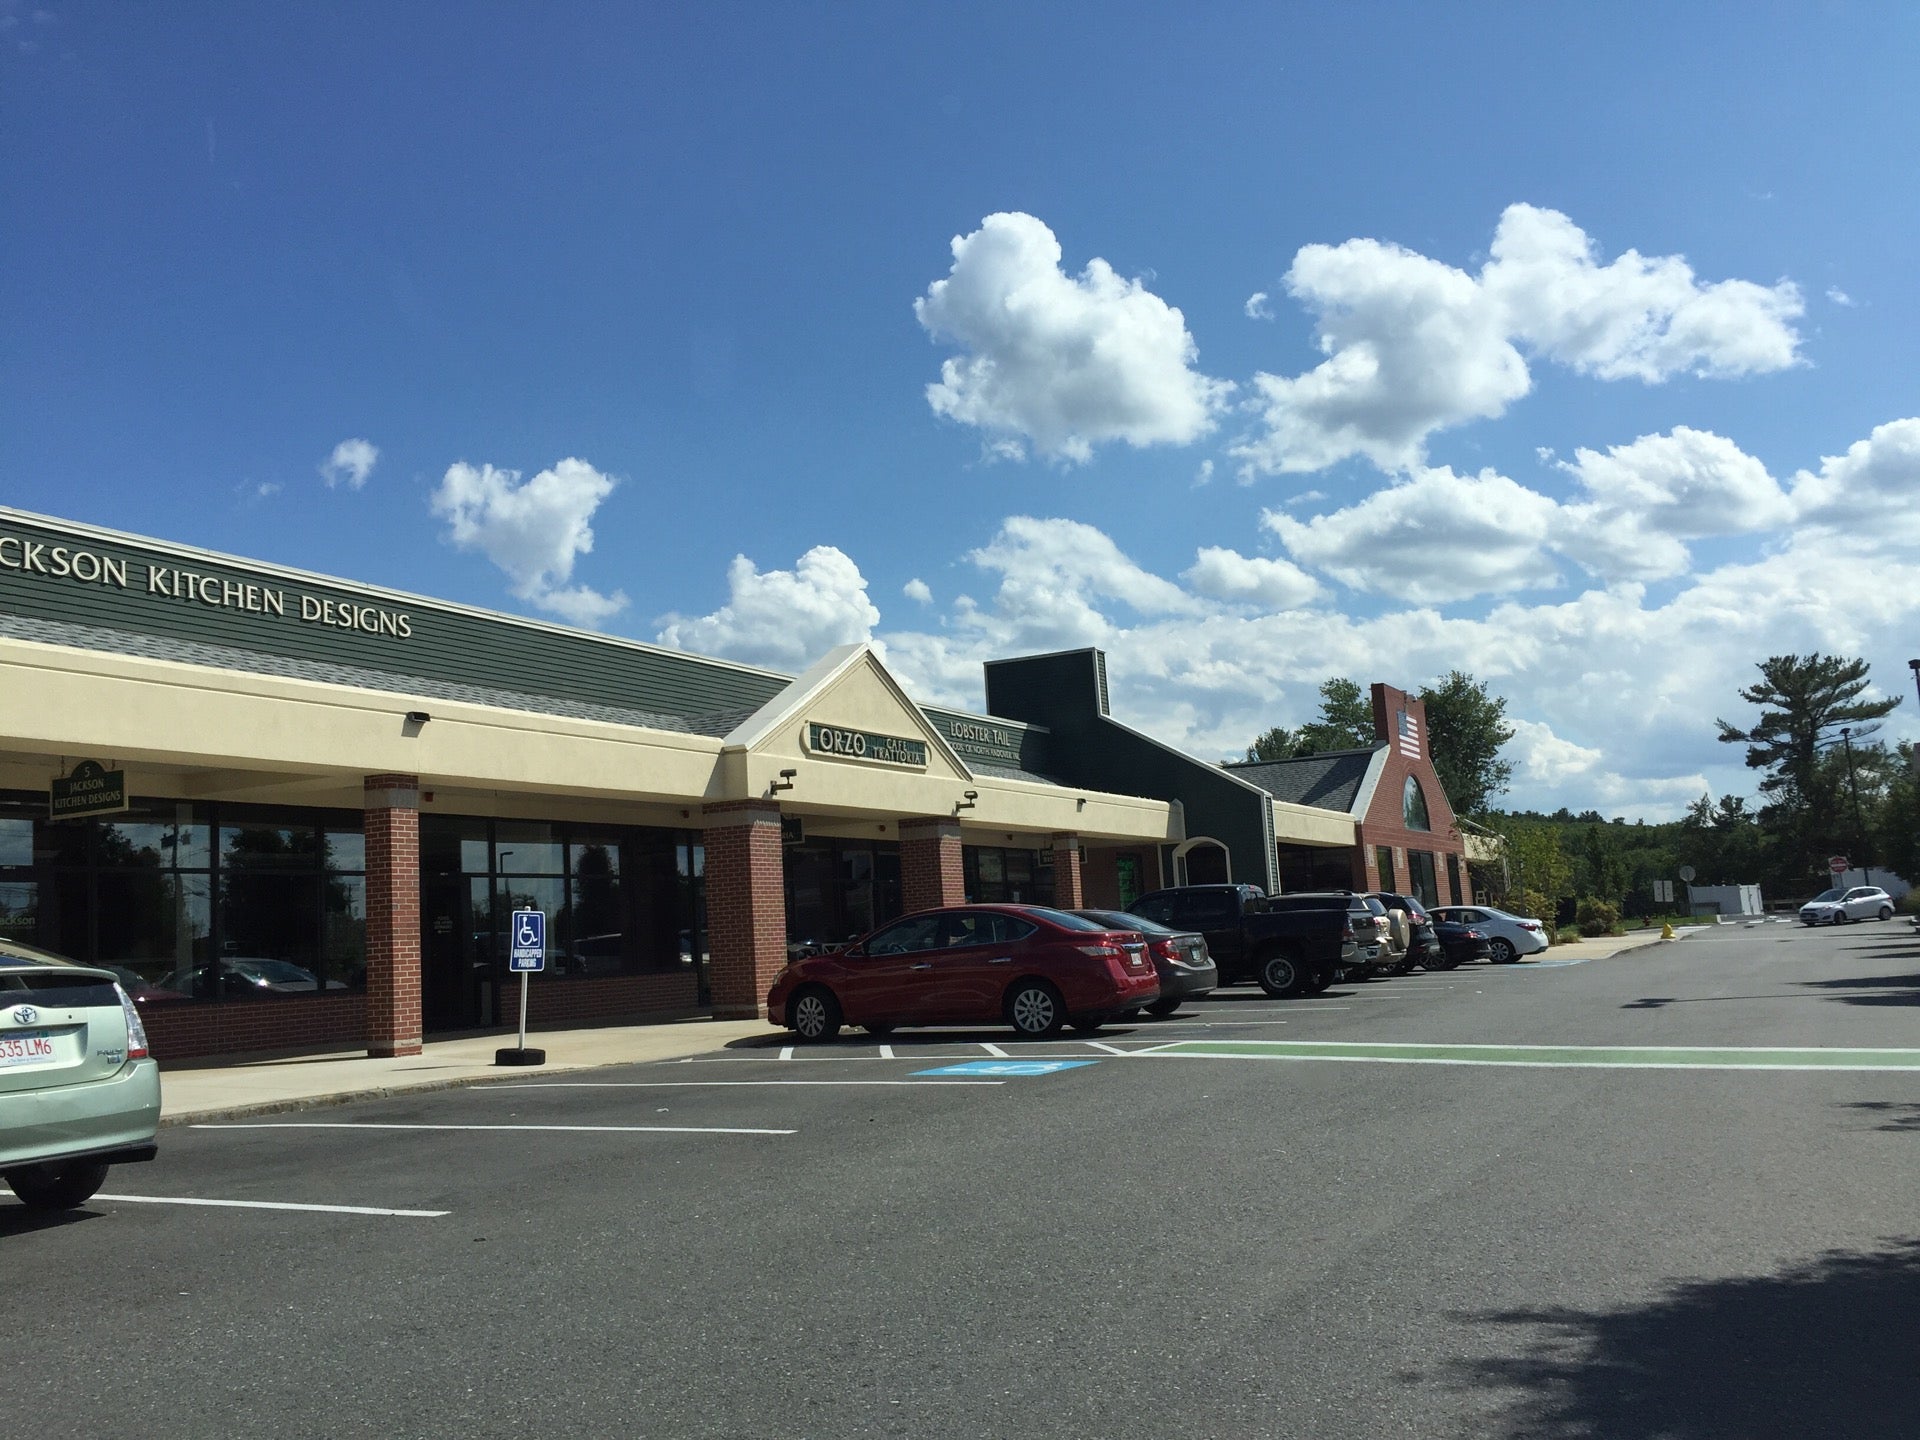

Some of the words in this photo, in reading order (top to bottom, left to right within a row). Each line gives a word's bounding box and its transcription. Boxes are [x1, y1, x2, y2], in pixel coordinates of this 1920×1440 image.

[0, 537, 127, 588] CKSON
[149, 565, 284, 616] KITCHEN
[301, 595, 412, 638] DESIGNS
[820, 728, 866, 755] ORZO
[950, 721, 990, 743] LOBSTER
[992, 729, 1011, 746] TAIL
[873, 746, 921, 764] TRATTORIA
[84, 766, 90, 778] 5
[70, 778, 105, 795] JACKSON
[55, 794, 87, 809] KITCHEN
[88, 790, 121, 805] DESIGNS
[513, 948, 543, 958] HANDICAPPED
[518, 958, 537, 968] PARKING
[25, 1038, 52, 1056] LM6
